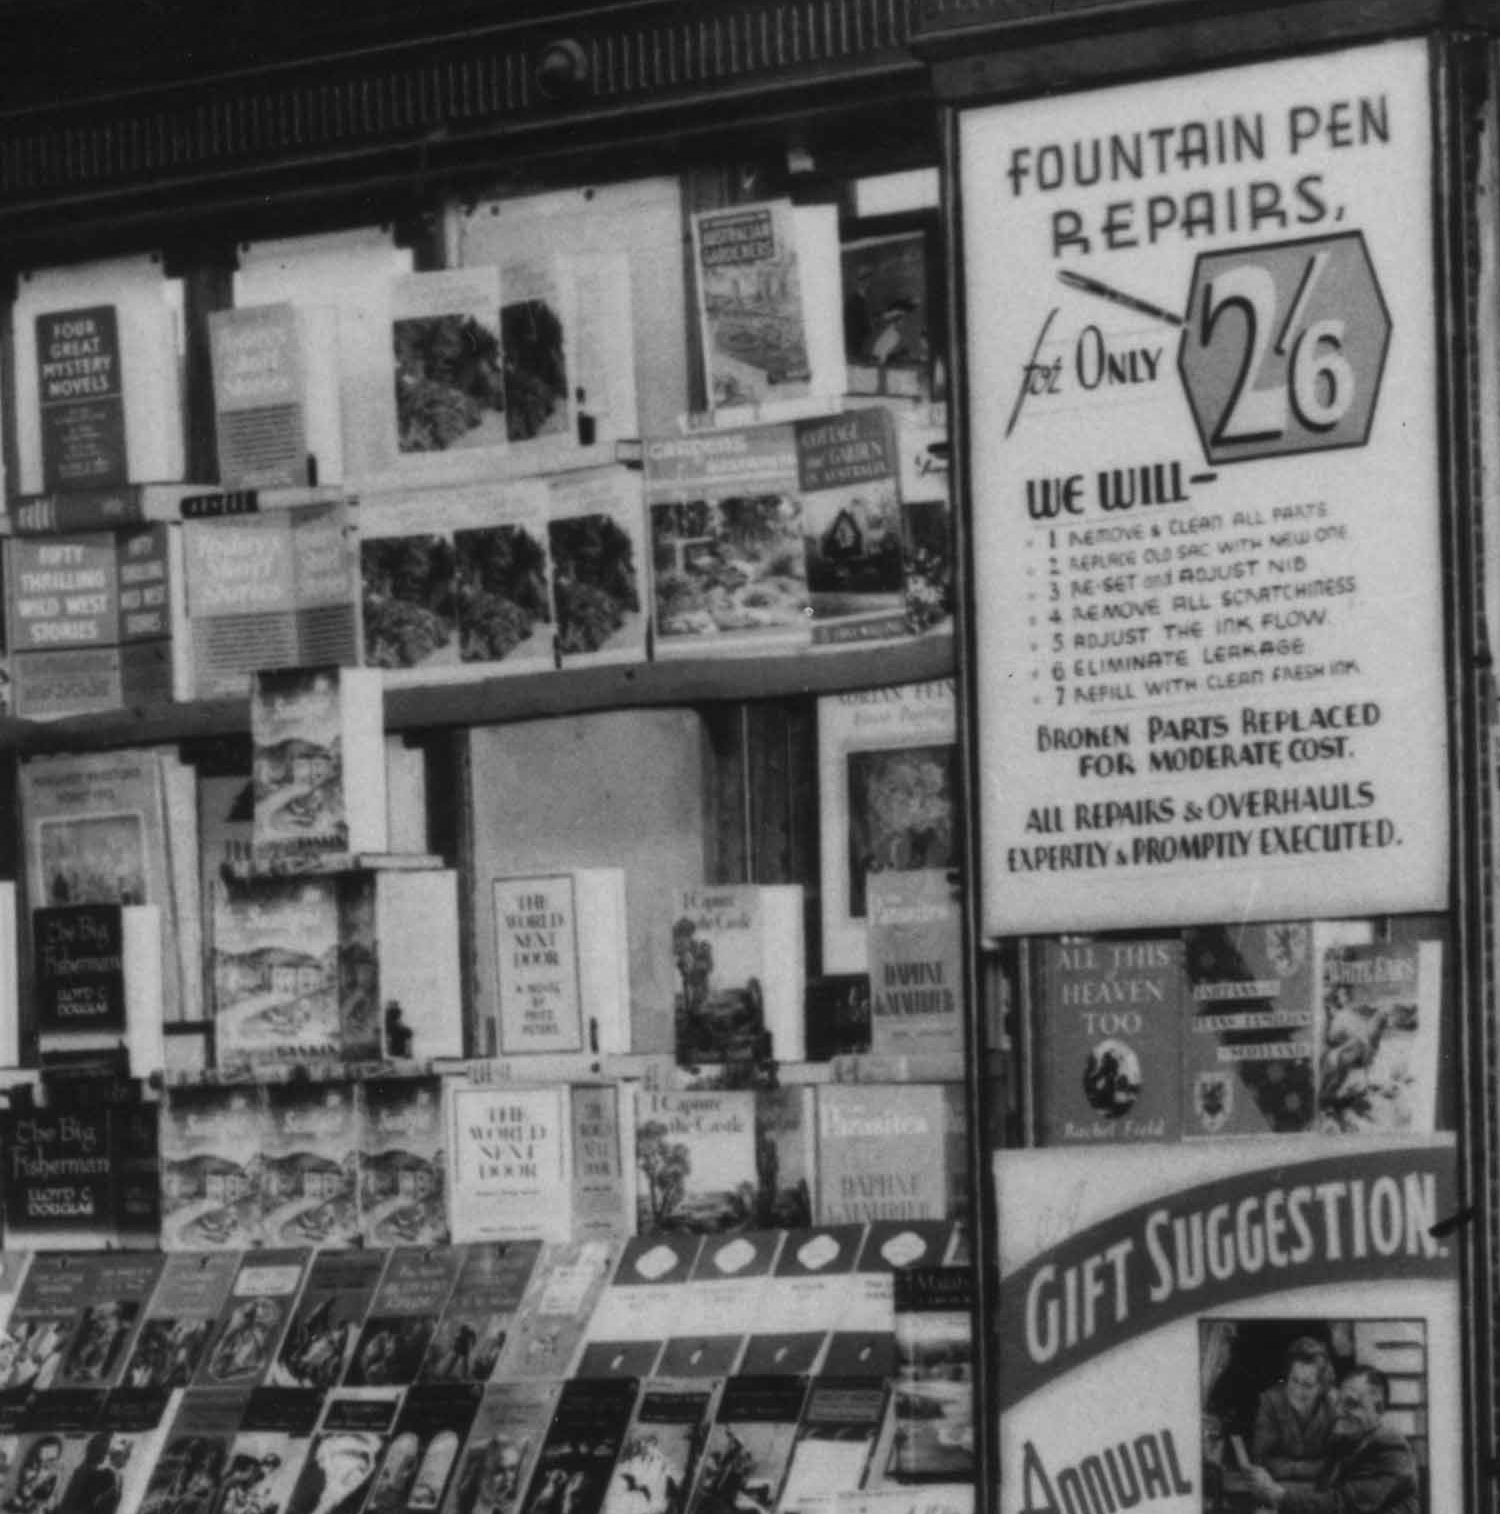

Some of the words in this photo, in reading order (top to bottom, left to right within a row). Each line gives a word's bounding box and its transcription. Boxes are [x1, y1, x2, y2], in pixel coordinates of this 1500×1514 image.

[1008, 112, 1264, 196] FOUNTAIN
[1289, 94, 1391, 155] PEN
[1052, 174, 1345, 258] REPAIRS,
[50, 336, 100, 359] GREAT
[53, 319, 95, 339] FOUR
[42, 354, 112, 379] MYSTERY
[1201, 251, 1356, 447] 2/6
[48, 375, 109, 397] NOVELS
[1027, 475, 1084, 520] WE
[1049, 531, 1056, 548] 1
[1069, 524, 1144, 547] REMOVE
[1169, 515, 1222, 536] CLEAN
[1233, 507, 1265, 526] ALL
[1272, 502, 1328, 523] PARTS
[1070, 553, 1136, 573] REPLACE
[1144, 548, 1171, 565] OLD
[1178, 544, 1208, 562] SAC
[1218, 537, 1262, 555] WITH
[1270, 531, 1310, 549] NEW
[1315, 525, 1347, 544] ONE
[1050, 583, 1060, 603] 3
[1179, 559, 1259, 584] ADJUST
[1268, 556, 1307, 575] NIB
[1049, 608, 1061, 625] 4
[1072, 599, 1160, 623] REMOVE
[1173, 595, 1211, 612] ALL
[1221, 575, 1357, 608] SCRATCHINESS
[1052, 632, 1064, 652] 5
[1074, 626, 1150, 651] ADJUST
[1164, 622, 1203, 642] THE
[1216, 615, 1255, 635] INK
[1052, 661, 1065, 682] 6
[1074, 650, 1189, 677] ELIMINATE
[1203, 638, 1305, 663] LEAKAGE
[1055, 686, 1066, 706] 7
[1074, 679, 1136, 704] REFILL
[1145, 677, 1198, 696] WITH
[1207, 670, 1264, 691] CLEAN
[1272, 664, 1326, 683] FRESH
[1329, 659, 1360, 676] INK
[1037, 724, 1130, 752] BROKEN
[1148, 715, 1229, 744] PARTS
[1242, 701, 1381, 736] REPLACED
[1079, 754, 1136, 778] FOR
[1149, 742, 1282, 773] MODERATE
[1289, 736, 1356, 763] COST.
[1025, 807, 1064, 835] ALL
[1075, 797, 1175, 831] REPAIRS
[1184, 801, 1203, 822] &
[1208, 781, 1376, 821] OVERHAULS
[1007, 841, 1111, 873] EXPERTLY
[1132, 829, 1252, 866] PROMPTLY
[1260, 817, 1402, 856] EXECUTED.
[506, 913, 565, 931] WORLD
[514, 932, 558, 950] NEXT
[1059, 947, 1096, 970] ALL
[1111, 942, 1171, 970] THIS
[512, 951, 560, 969] DOOR
[1060, 979, 1165, 1005] HEAVEN
[1081, 1011, 1143, 1036] TOO
[16, 1119, 56, 1143] The
[59, 1116, 97, 1153] Big
[469, 1125, 548, 1143] WORLD
[11, 1145, 111, 1178] Fisherman
[478, 1164, 538, 1181] DOOR
[28, 1188, 77, 1204] LLOYD
[28, 1202, 95, 1217] DOUGLAS
[1024, 1238, 1134, 1364] GIFT
[1145, 1172, 1450, 1304] SUGGESTION.
